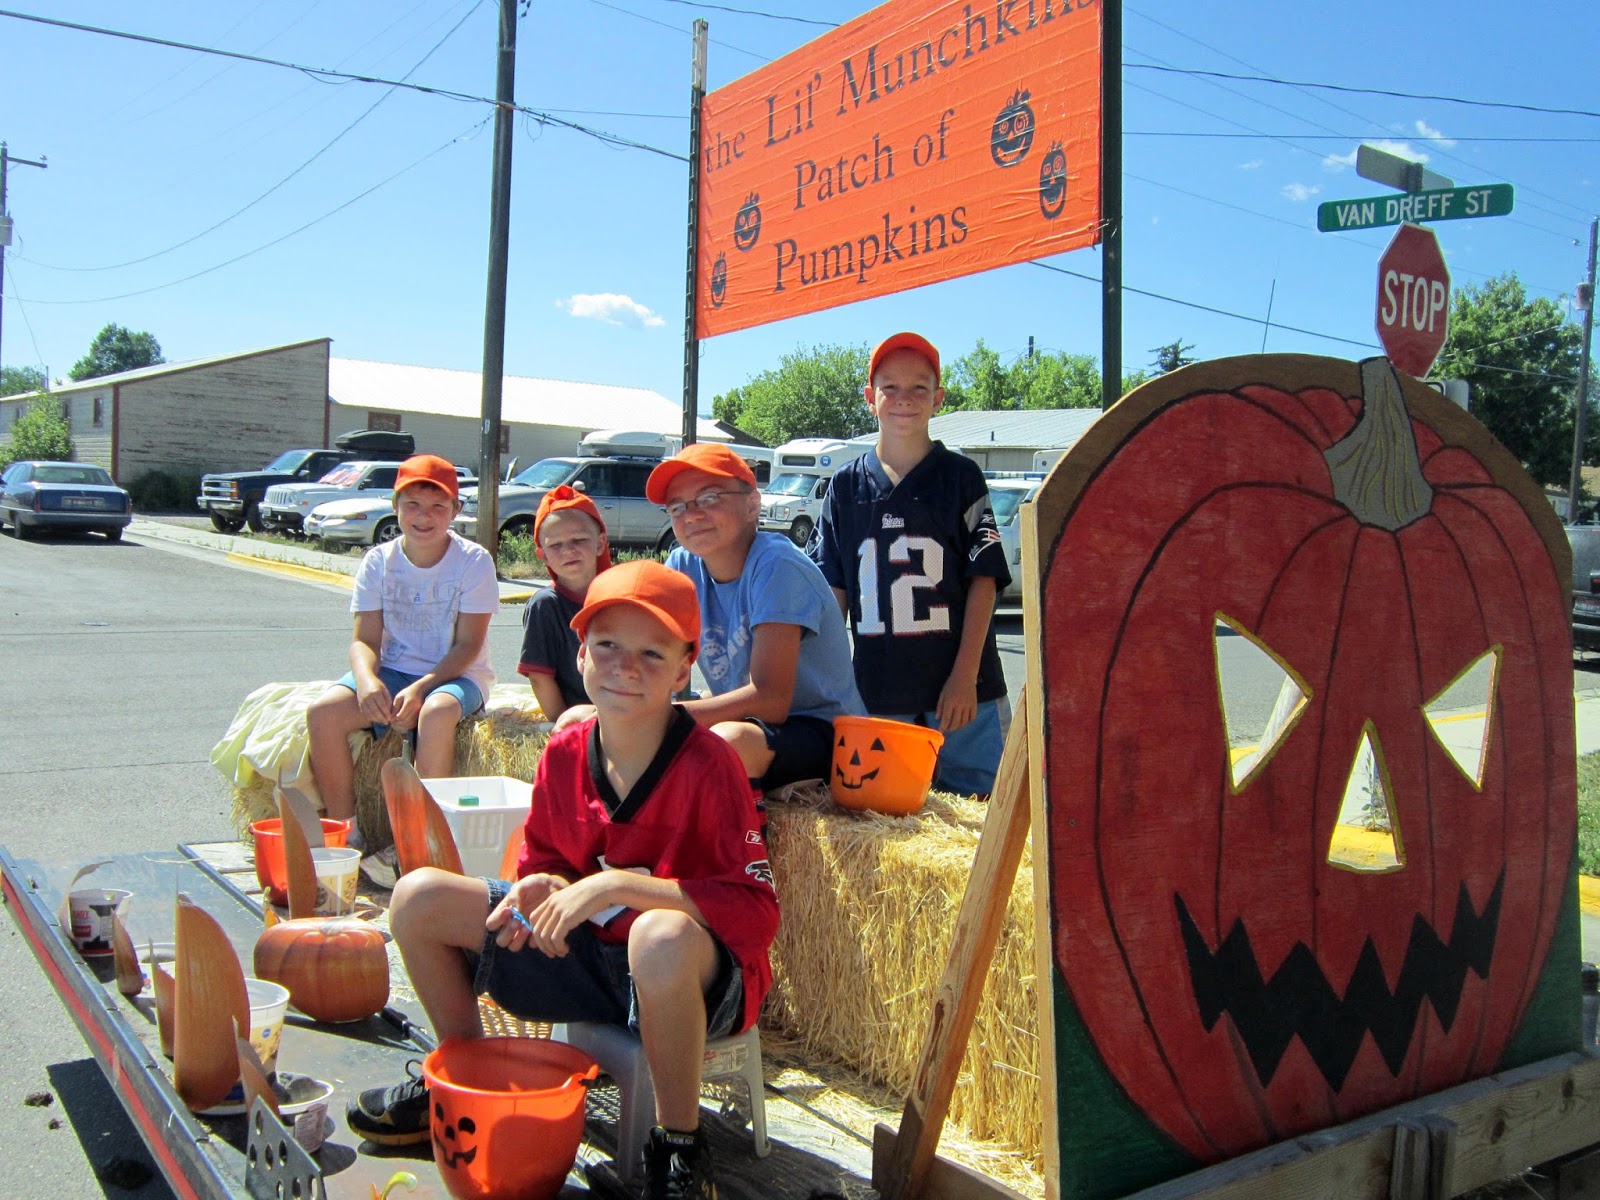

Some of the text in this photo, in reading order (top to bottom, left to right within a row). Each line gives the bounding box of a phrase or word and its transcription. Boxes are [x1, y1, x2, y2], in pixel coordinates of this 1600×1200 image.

[705, 129, 746, 173] the
[836, 0, 1094, 116] Munchkin
[793, 108, 956, 212] Patch of
[774, 205, 968, 293] Pumpkins
[1336, 189, 1493, 227] VAN DREFF ST
[1381, 269, 1446, 333] STOP
[856, 534, 950, 636] 12
